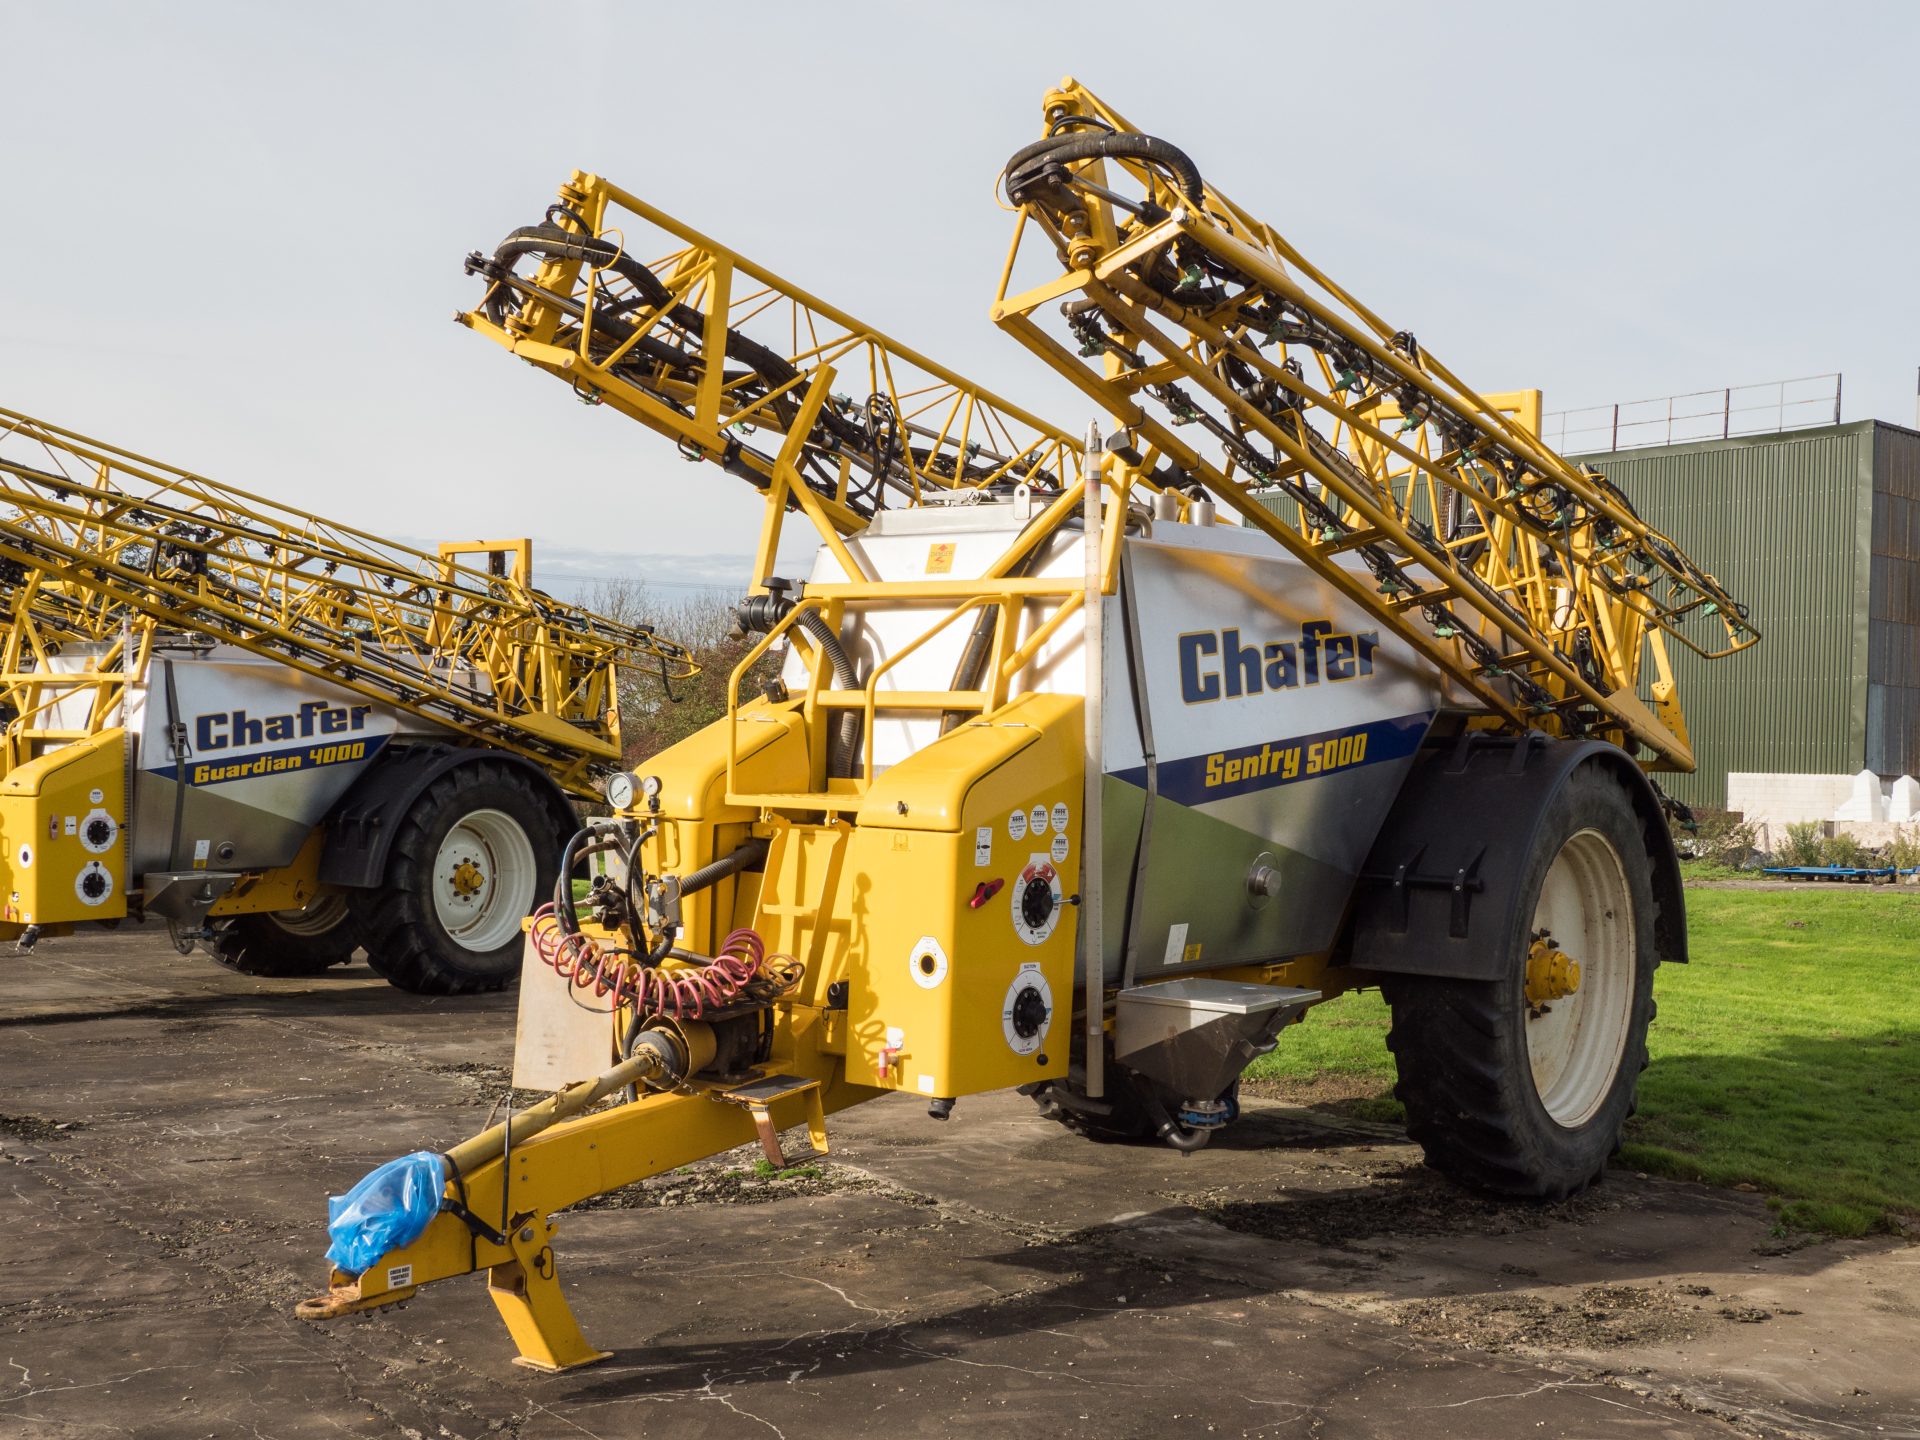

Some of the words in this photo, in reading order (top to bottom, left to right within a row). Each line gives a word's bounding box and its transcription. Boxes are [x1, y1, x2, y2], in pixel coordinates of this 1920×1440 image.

[1178, 618, 1380, 706] Chafer
[196, 700, 372, 752] Chafer
[194, 754, 302, 784] Guardian
[309, 742, 365, 765] 4000
[1205, 744, 1301, 788] Sentry
[1306, 733, 1368, 775] 5000
